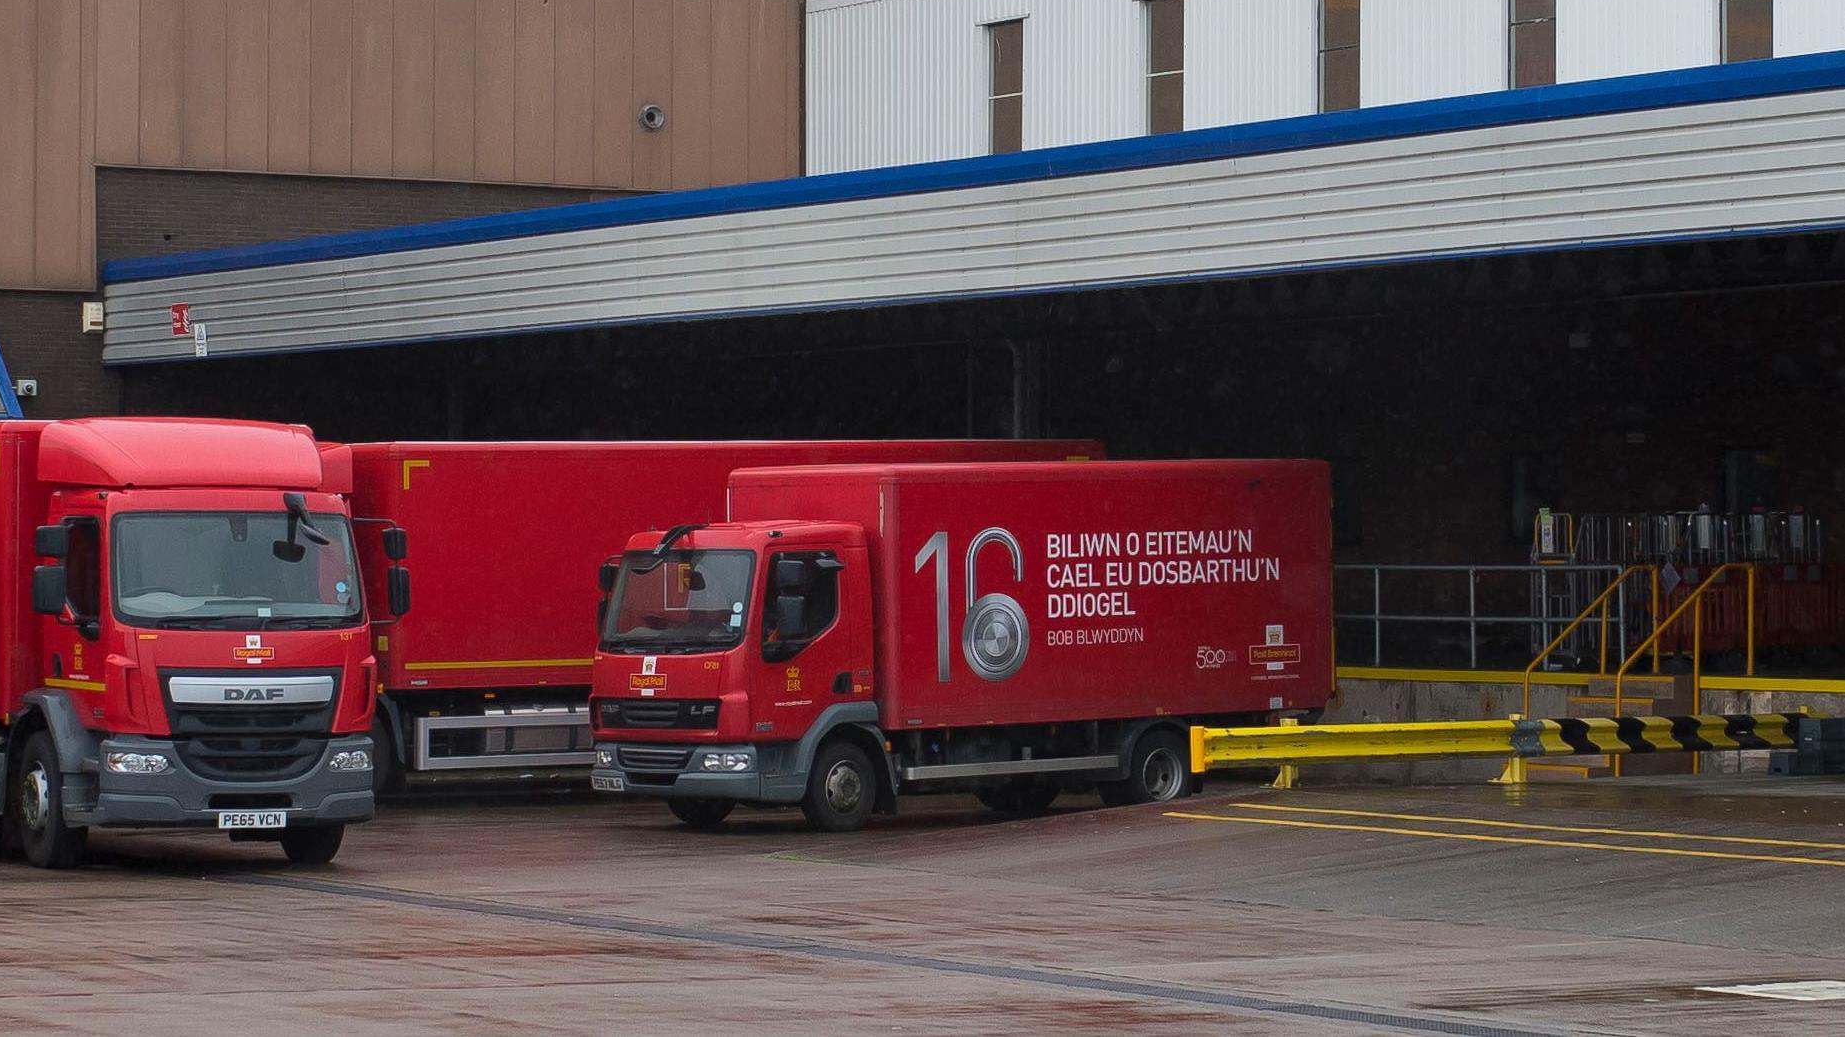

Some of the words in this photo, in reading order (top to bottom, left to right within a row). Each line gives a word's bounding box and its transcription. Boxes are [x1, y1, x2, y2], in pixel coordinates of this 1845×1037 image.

[1047, 533, 1121, 559] BILIWN
[1126, 533, 1140, 556] O
[1146, 529, 1253, 556] EITEMAU'N
[1047, 562, 1101, 589] CAEL
[1106, 562, 1133, 586] EU
[1138, 558, 1281, 585] DOSBARTHU'N
[1047, 592, 1137, 618] DDIOGEL
[1047, 630, 1073, 646] BOB
[1077, 627, 1144, 644] BLWYDDYN
[1196, 649, 1226, 669] 500
[223, 688, 284, 701] DAF
[690, 705, 716, 715] LF
[223, 814, 255, 826] PE65
[258, 813, 281, 826] VCN
